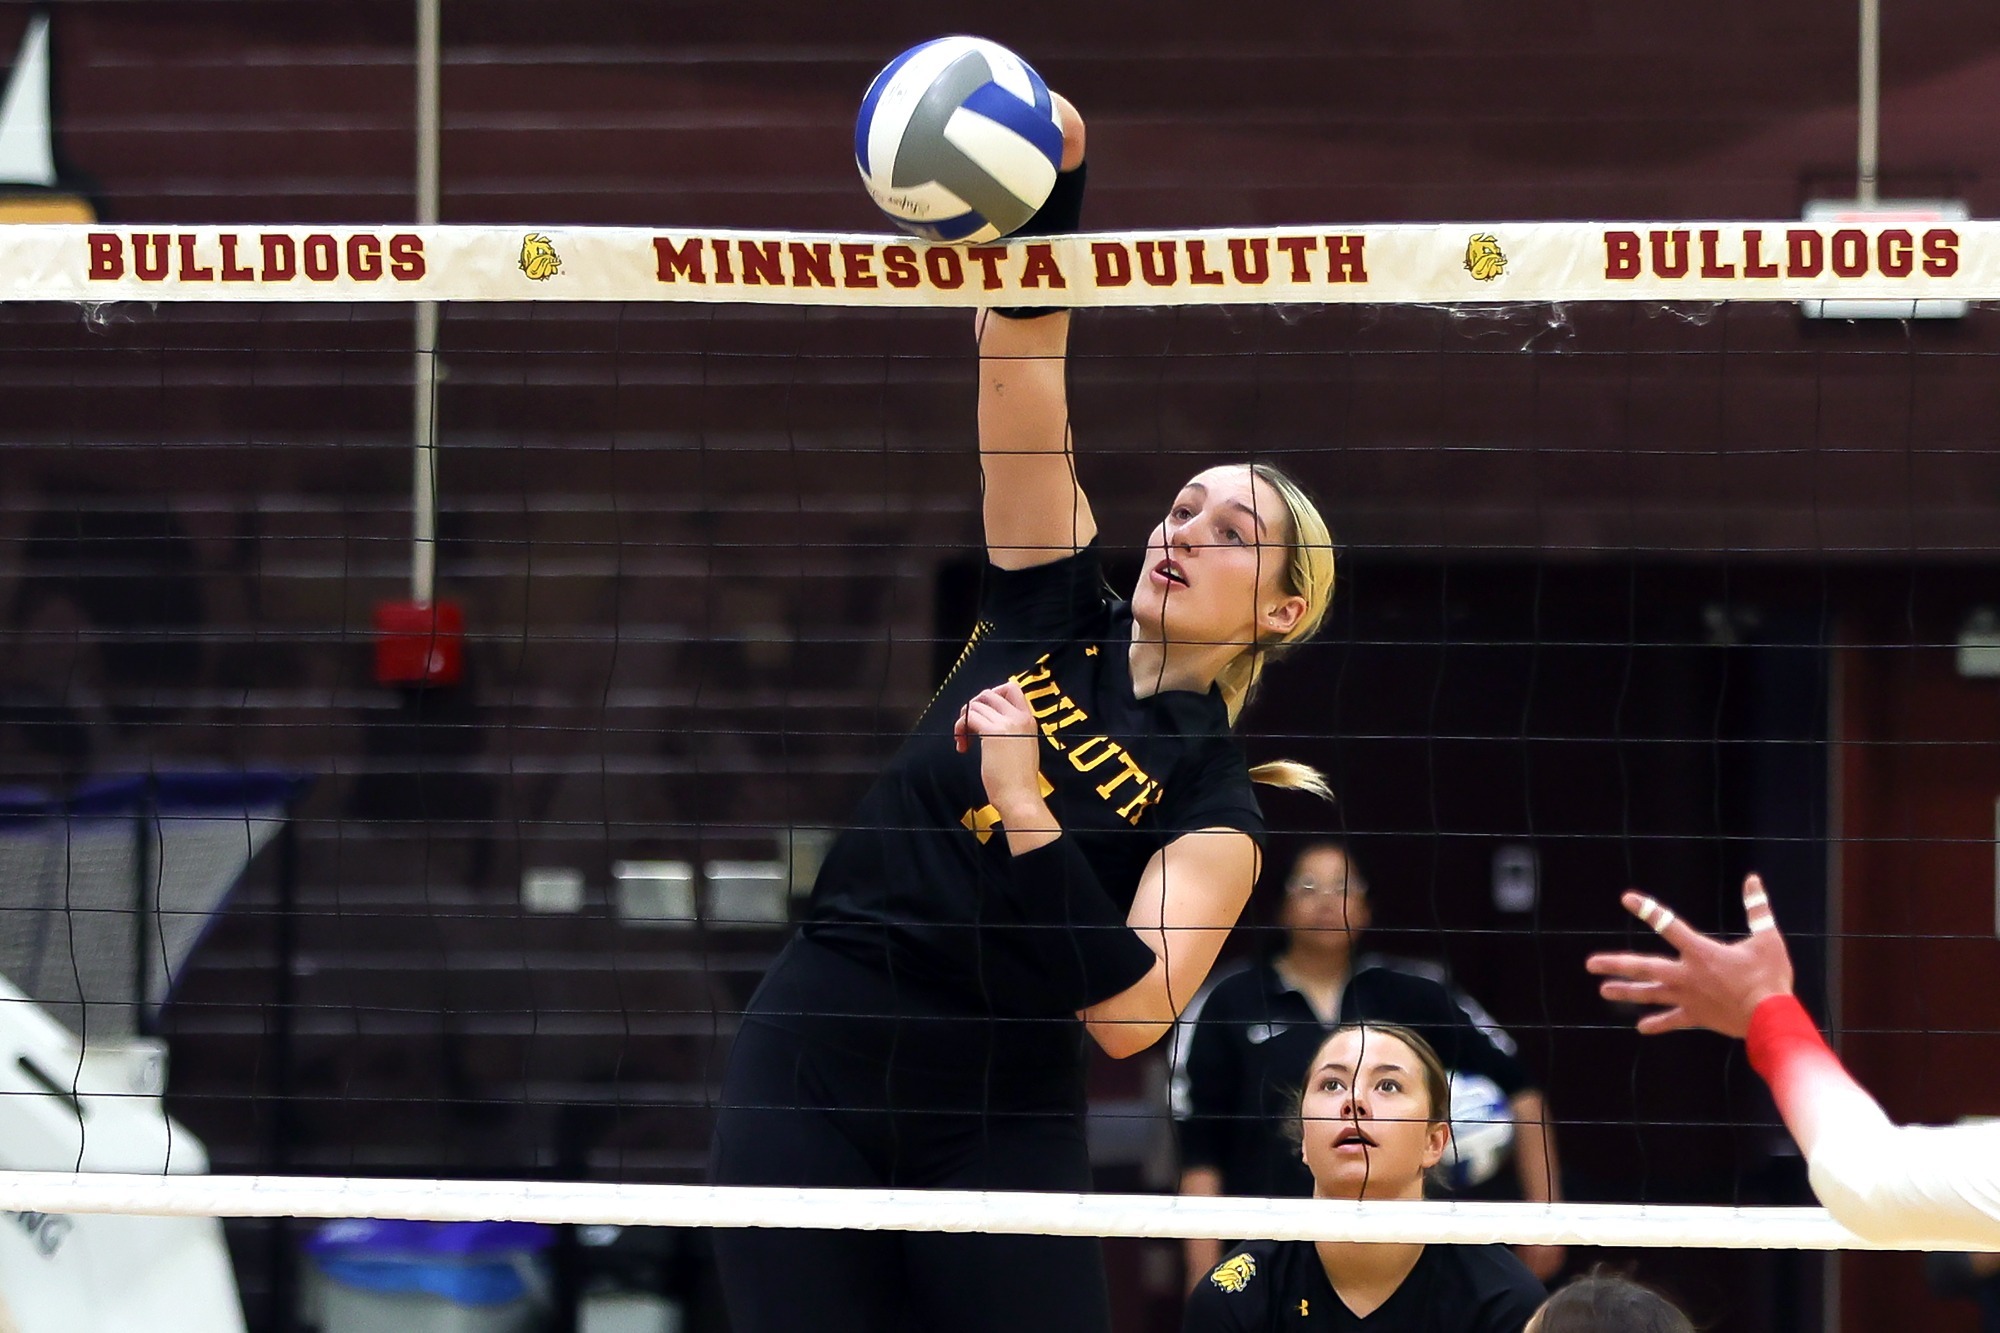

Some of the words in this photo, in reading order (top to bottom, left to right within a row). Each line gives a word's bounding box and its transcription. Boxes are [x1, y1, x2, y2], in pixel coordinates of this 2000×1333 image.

[87, 232, 427, 283] BULLDOGS
[653, 236, 1068, 291] MINNESOTA
[1090, 235, 1369, 288] DULUTH
[1603, 227, 1960, 280] BULLDOGS
